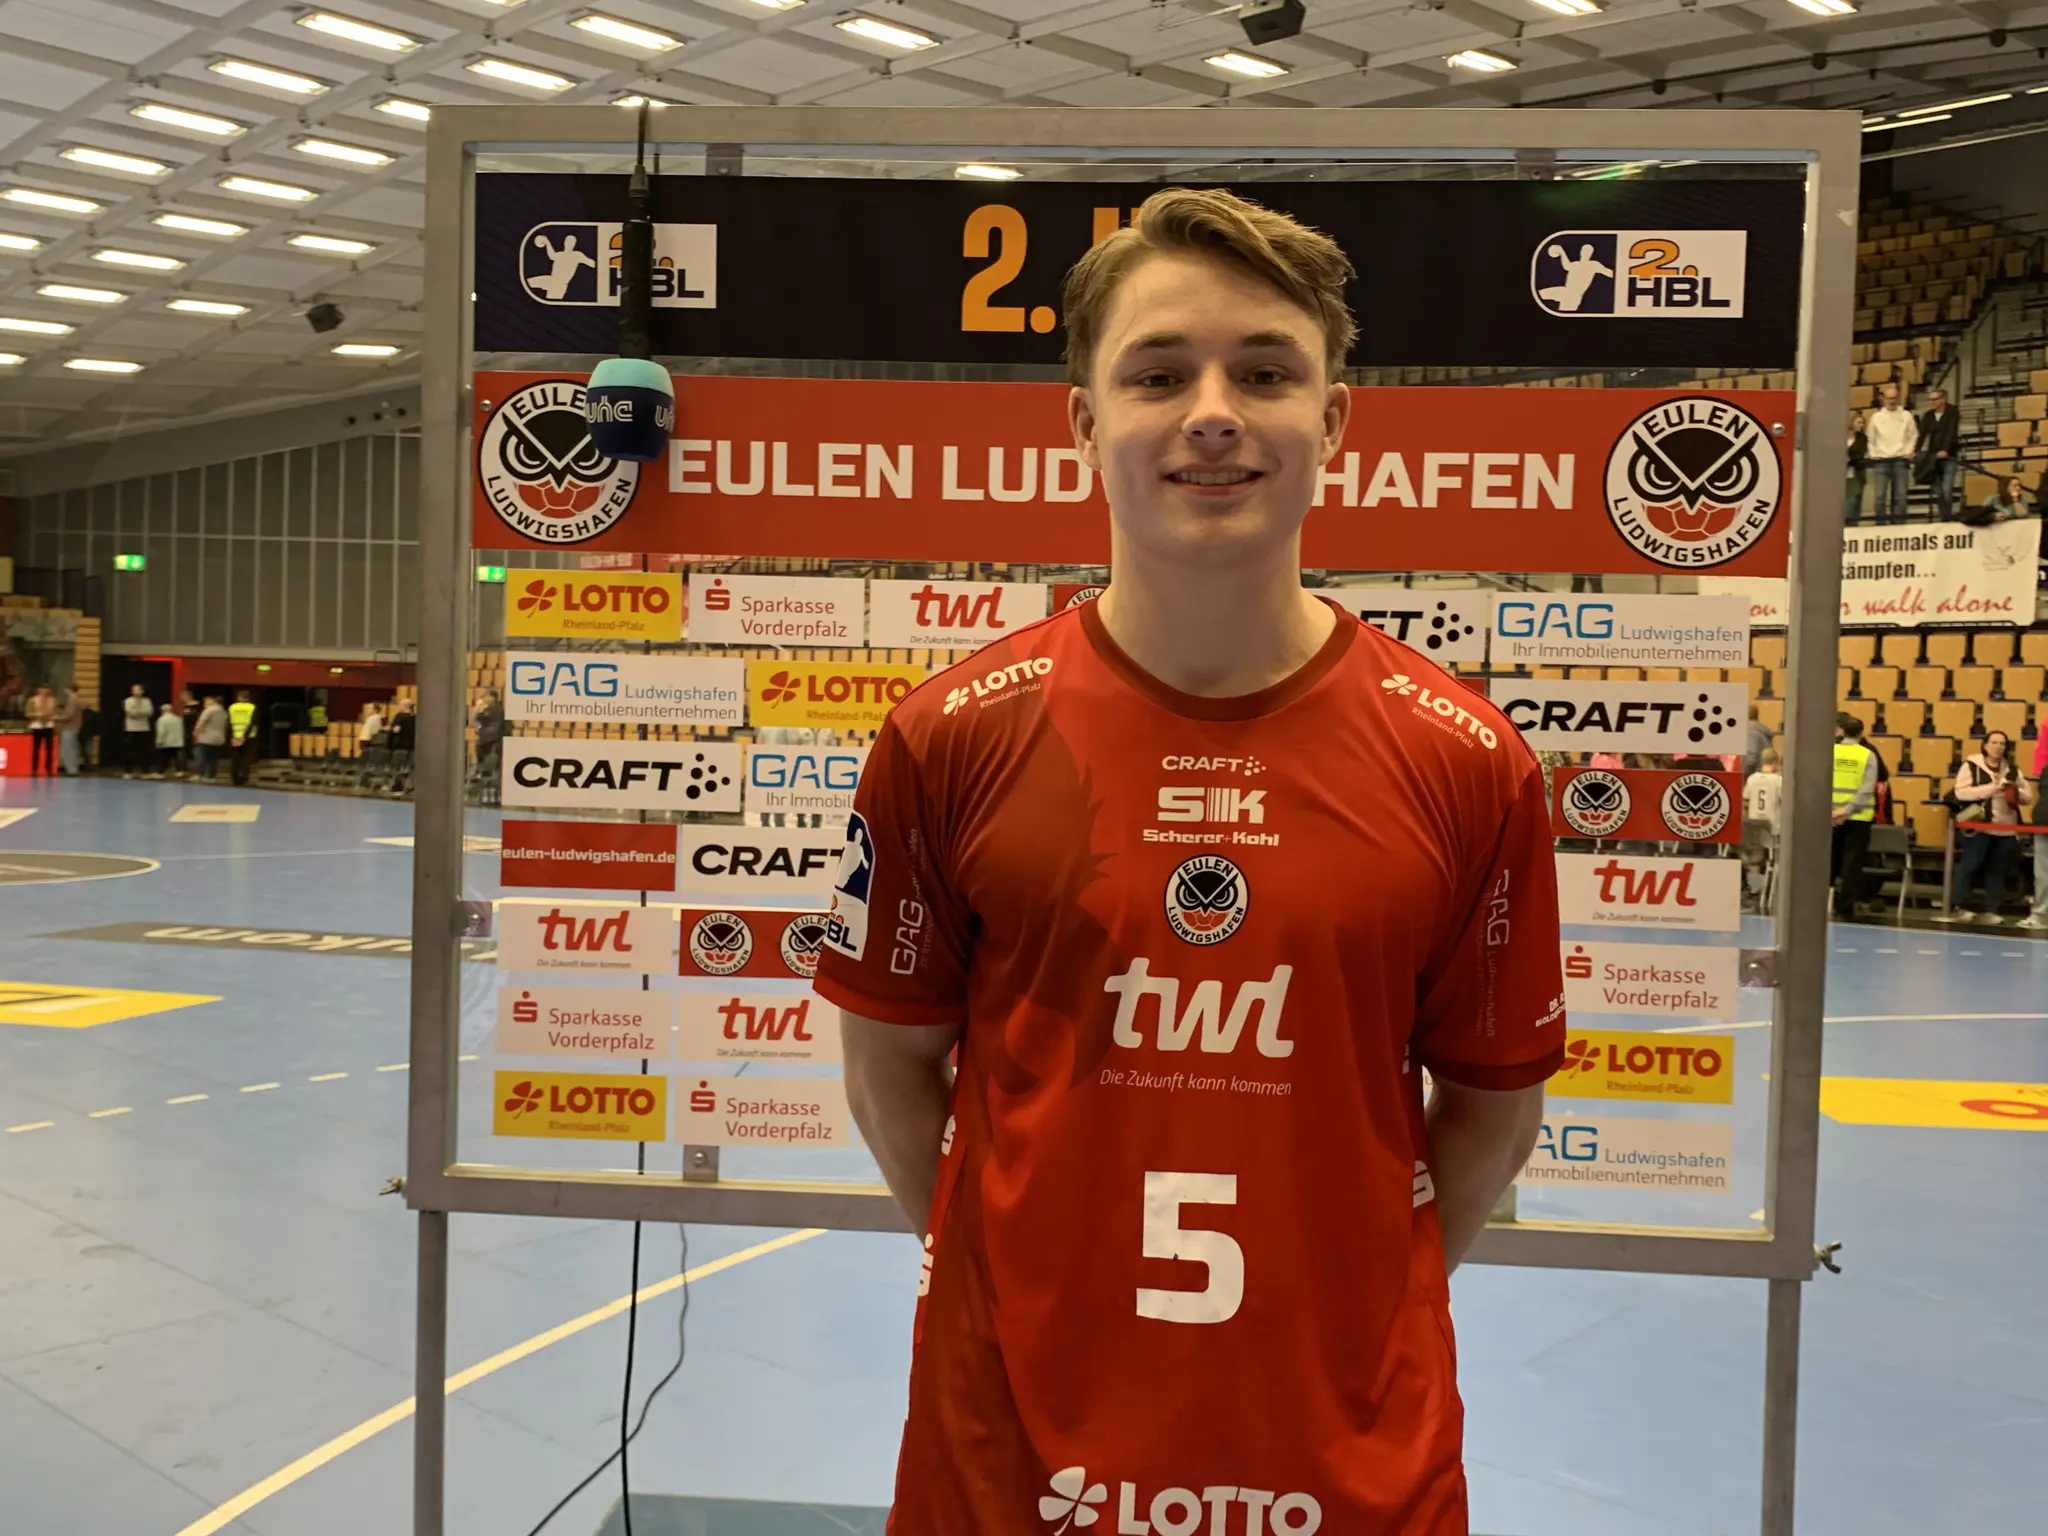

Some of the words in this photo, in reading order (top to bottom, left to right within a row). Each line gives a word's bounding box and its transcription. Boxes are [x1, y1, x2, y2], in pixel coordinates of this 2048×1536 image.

[961, 204, 1056, 334] 2.
[1628, 238, 1699, 278] 2.
[1627, 276, 1732, 309] HBL
[1642, 403, 1750, 440] EULEN
[668, 438, 913, 500] EULEN
[487, 475, 633, 540] LUDWIGSHAFEN
[1613, 497, 1772, 563] LUDWIGSHAFEN
[1864, 533, 1939, 552] niemals
[1944, 531, 1975, 549] auf
[563, 583, 670, 615] LOTTO
[741, 596, 835, 616] Sparkasse
[910, 585, 1006, 629] twl
[1862, 585, 1927, 615] walk
[1935, 584, 2014, 614] alone
[562, 619, 645, 632] Rheinland-Pfalz
[740, 619, 848, 640] Vorderpfalz
[1498, 602, 1614, 639] GAG
[1621, 624, 1744, 645] Ludwigshafen
[1513, 643, 1535, 657] Ihr
[1538, 643, 1742, 662] Immobilienunternehmen
[511, 661, 618, 698] GAG
[625, 684, 738, 704] Ludwigshafen
[807, 675, 913, 705] LOTTO
[971, 656, 1054, 698] LOTTO
[526, 699, 544, 714] Ihr
[550, 700, 738, 720] Immobilienunternehmen
[979, 682, 1042, 709] Rheinland-Pfalz
[1411, 706, 1475, 750] Rheinland-Pfalz
[1418, 688, 1498, 750] LOTTO
[1503, 698, 1684, 734] CRAFT
[513, 756, 683, 791] CRAFT
[752, 754, 859, 790] GAG
[1161, 755, 1244, 773] CRAFT
[1576, 772, 1618, 787] EULEN
[1675, 775, 1718, 790] EULEN
[766, 792, 786, 806] Ihr
[1565, 808, 1627, 834] LUDWIGSHAFEN
[1665, 811, 1726, 838] LUDWIGSHAFEN
[1142, 828, 1280, 847] Scherer+Kohl
[502, 847, 676, 870] eulen-ludwigshafen.de
[1181, 857, 1235, 878] EULEN
[1593, 859, 1698, 907] twl
[538, 908, 633, 953] twl
[702, 914, 741, 928] EULEN
[1168, 905, 1245, 944] LUDWIGSHAFEN
[890, 898, 924, 975] GAG
[692, 948, 750, 973] LUDWIGSHAFEN
[1604, 964, 1706, 985] Sparkasse
[1103, 957, 1295, 1059] twl
[1603, 988, 1719, 1011] Vorderpfalz
[549, 1008, 643, 1028] Sparkasse
[718, 997, 813, 1042] twl
[548, 1031, 655, 1053] Vorderpfalz
[1608, 1044, 1722, 1077] LOTTO
[1100, 1069, 1123, 1086] Die
[1127, 1070, 1185, 1093] Zukunft
[1188, 1072, 1227, 1091] kann
[1231, 1076, 1292, 1096] kommen
[550, 1085, 656, 1116] LOTTO
[726, 1097, 821, 1118] Sparkasse
[725, 1120, 833, 1142] Vorderpfalz
[1605, 1148, 1726, 1170] Ludwigshafen
[1525, 1165, 1726, 1189] Immobilienunternehmen
[1136, 1170, 1245, 1324] 5
[1117, 1481, 1323, 1536] LOTTO
